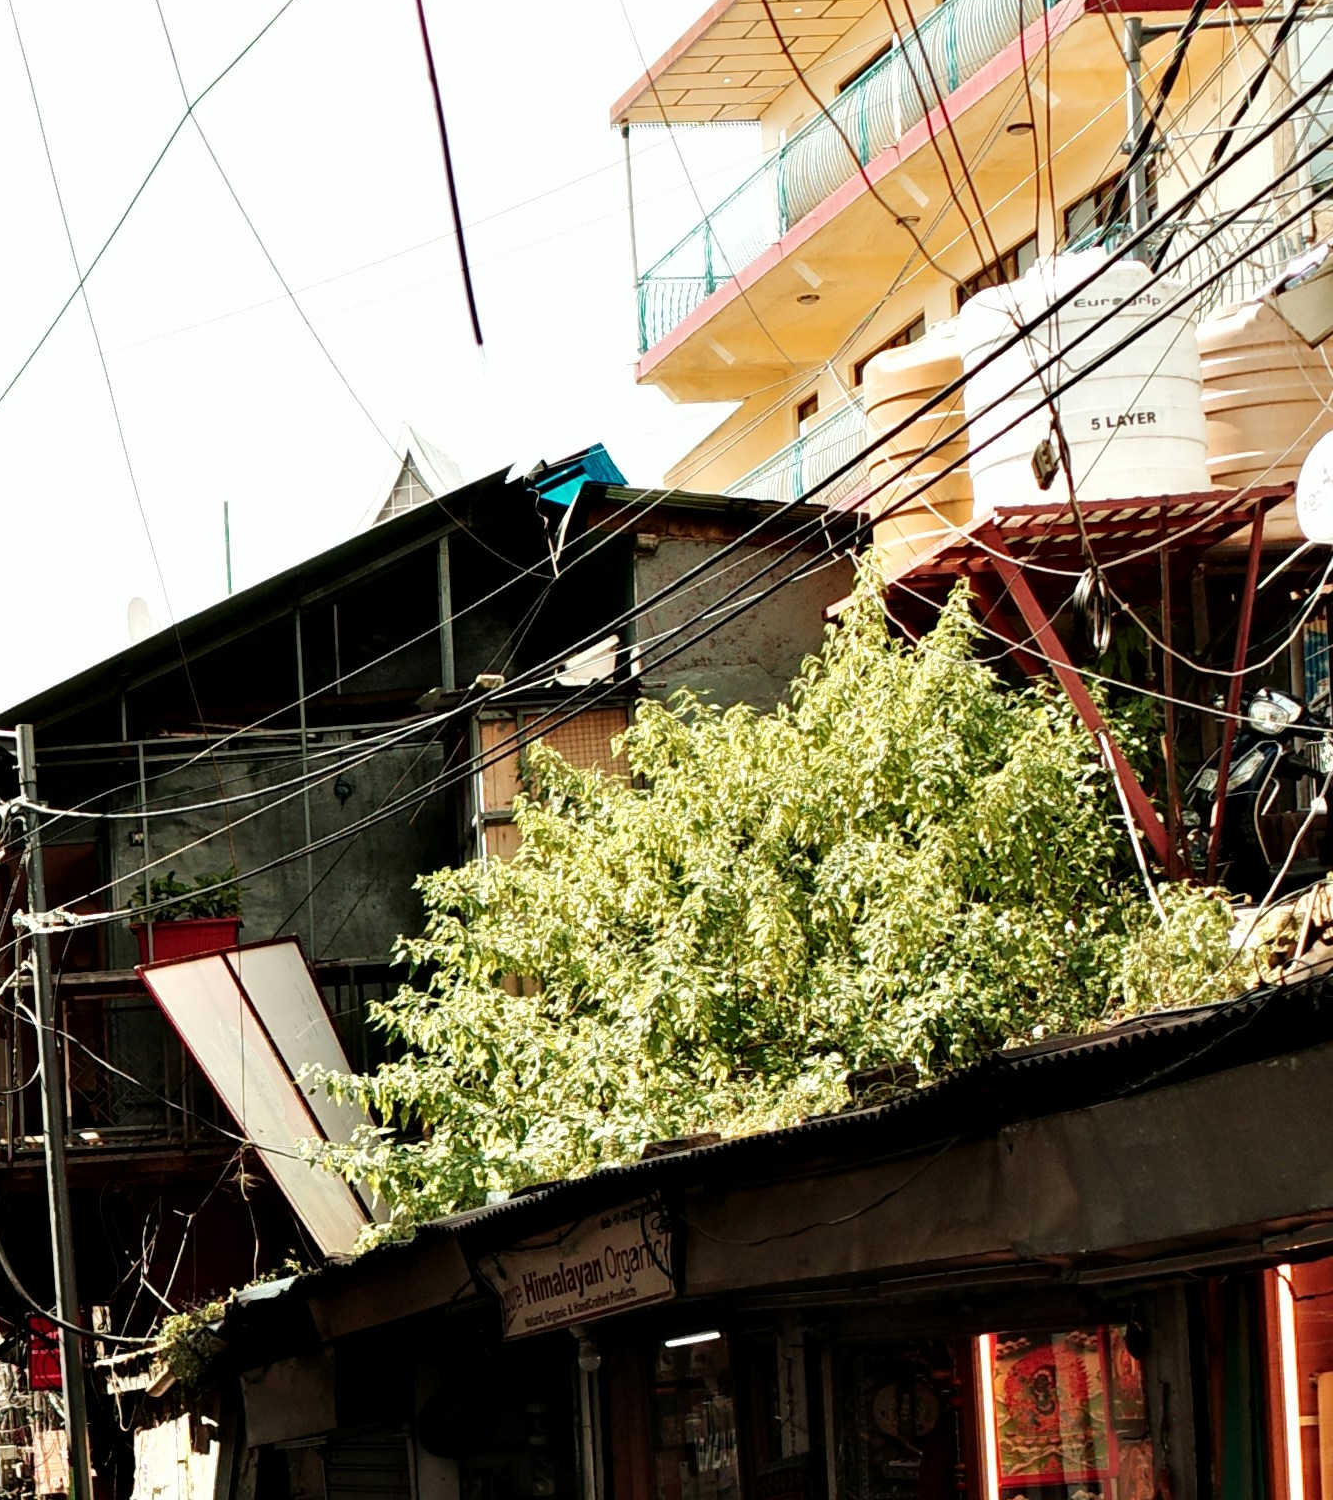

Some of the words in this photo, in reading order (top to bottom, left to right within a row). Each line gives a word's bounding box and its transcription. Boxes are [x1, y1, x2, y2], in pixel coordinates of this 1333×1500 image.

[1091, 418, 1101, 430] 5
[1106, 411, 1156, 428] LAYER
[522, 1258, 603, 1305] Himalayan
[545, 1307, 567, 1324] Organic
